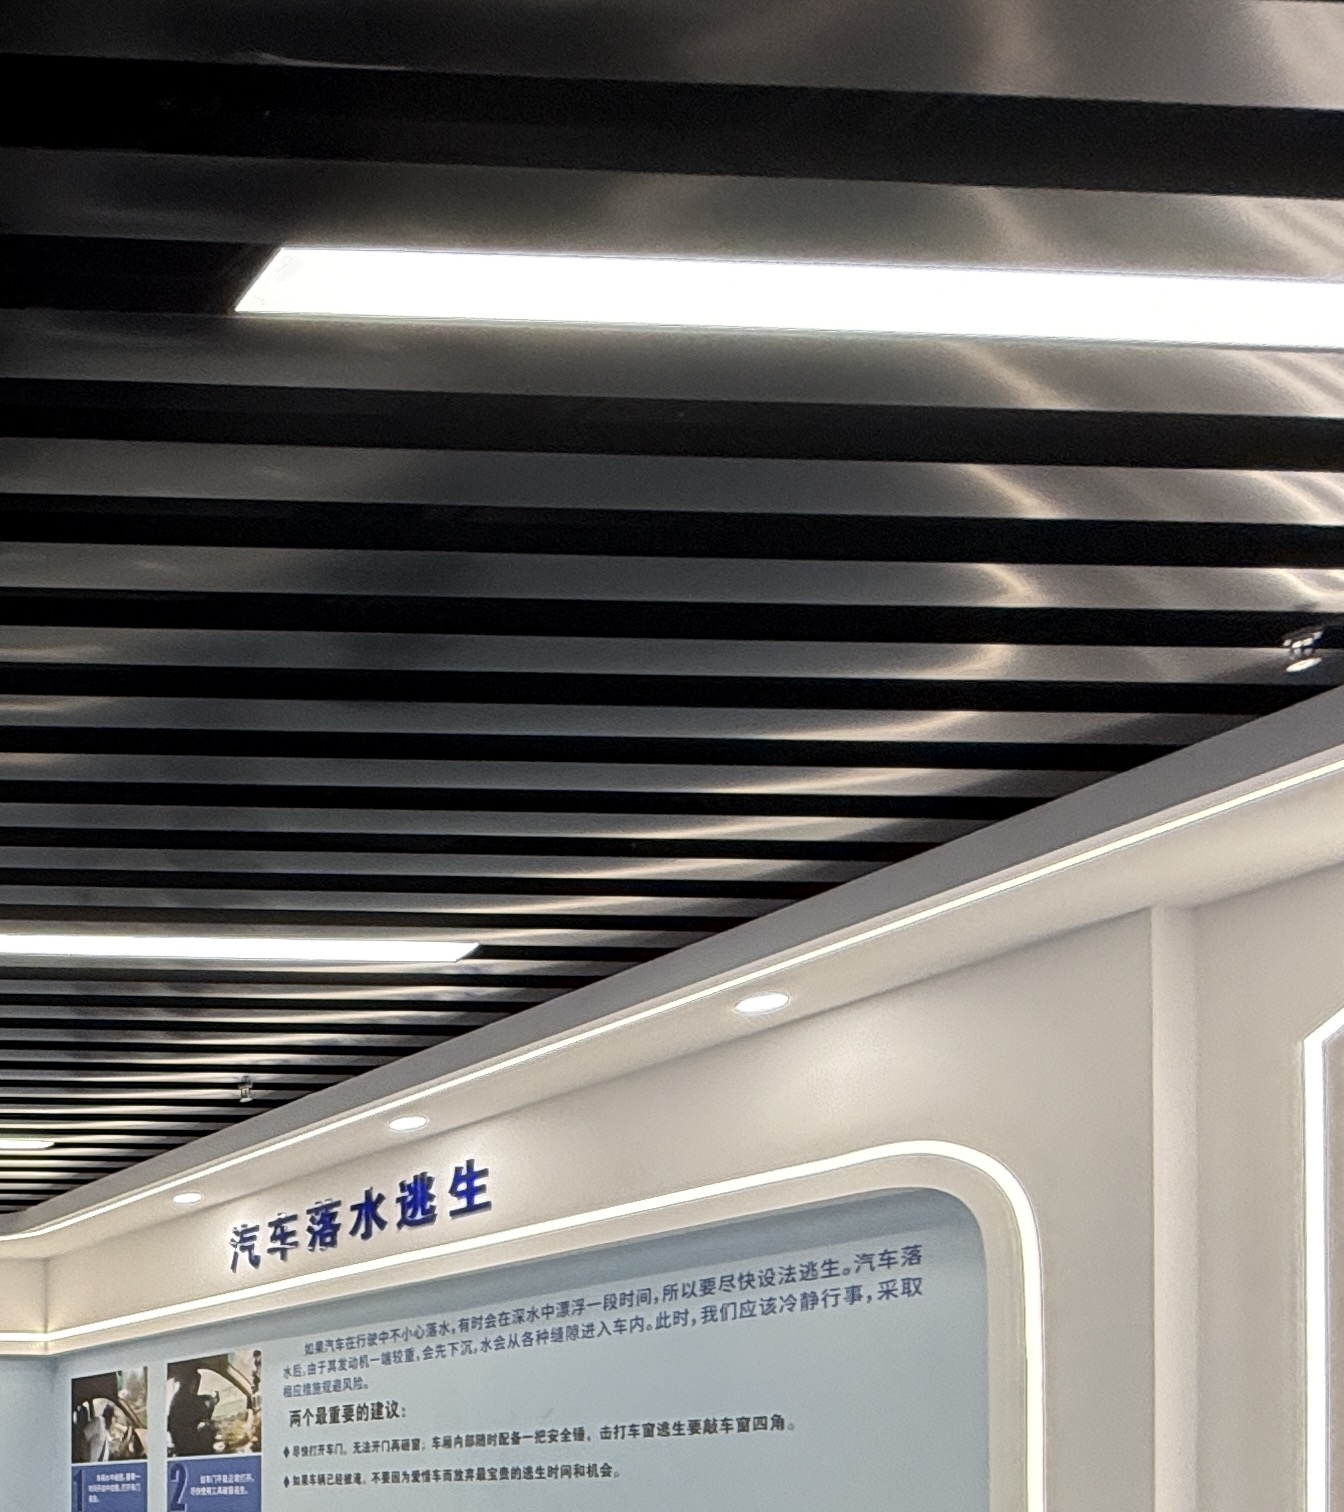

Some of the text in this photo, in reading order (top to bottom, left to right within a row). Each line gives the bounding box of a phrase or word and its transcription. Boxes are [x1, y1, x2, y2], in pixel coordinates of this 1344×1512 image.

[229, 1158, 493, 1274] 汽车落水逃生
[171, 1463, 187, 1512] 2
